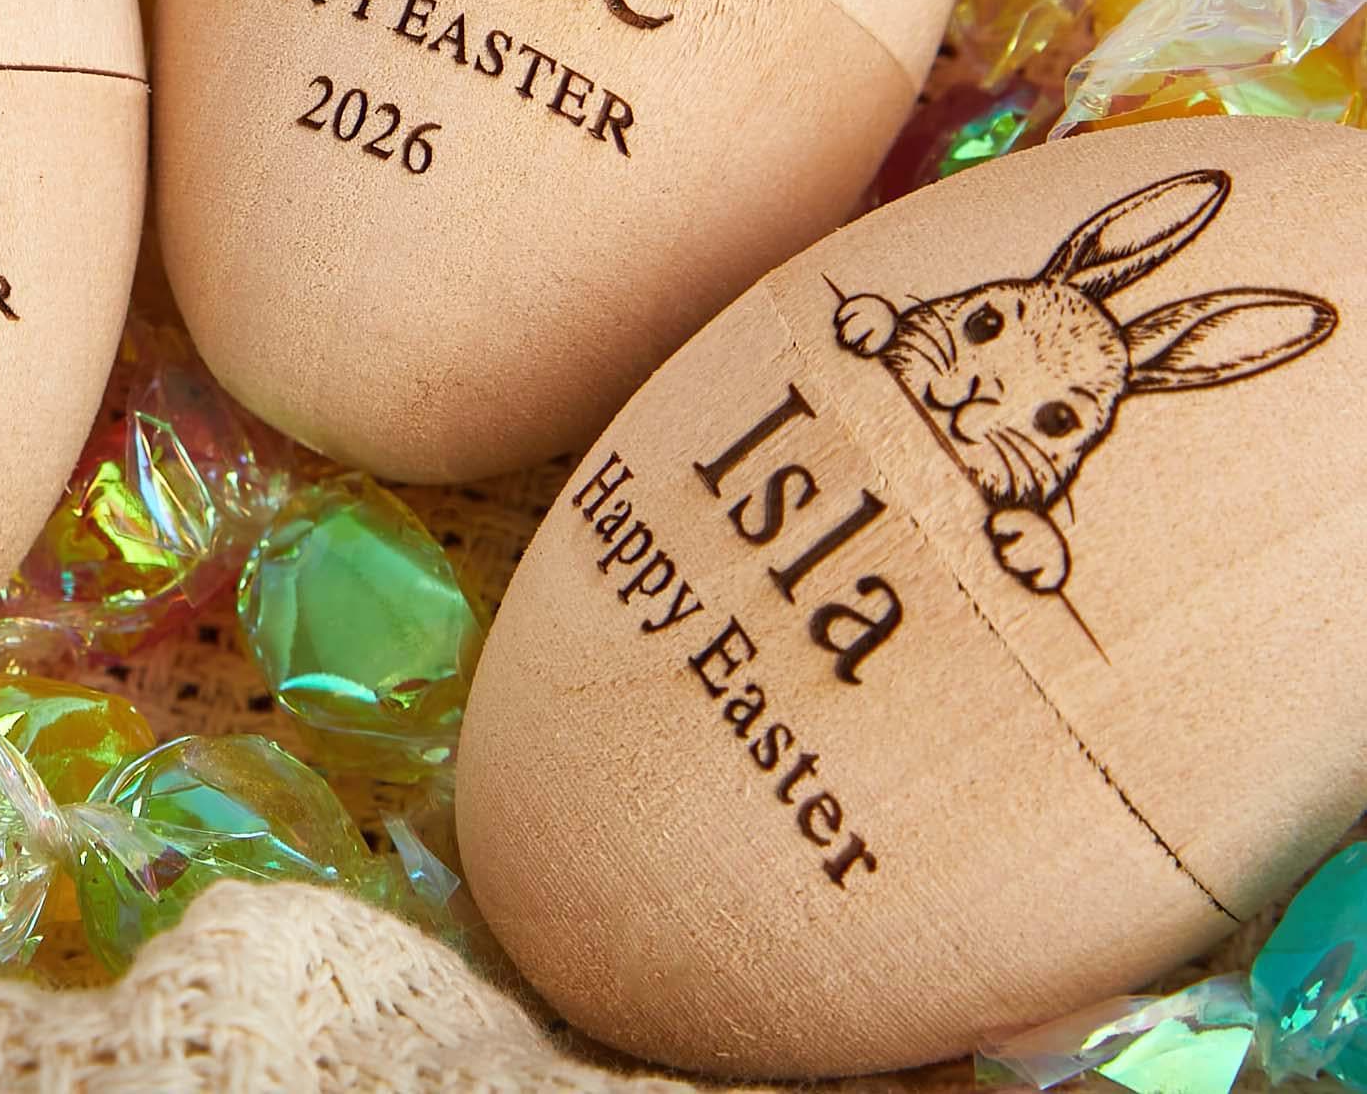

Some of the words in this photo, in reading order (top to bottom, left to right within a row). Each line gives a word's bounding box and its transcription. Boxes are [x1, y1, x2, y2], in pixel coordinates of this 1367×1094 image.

[295, 75, 443, 175] 2026
[571, 450, 706, 636] Happy
[687, 614, 879, 891] Easter
[692, 382, 904, 686] Isla
